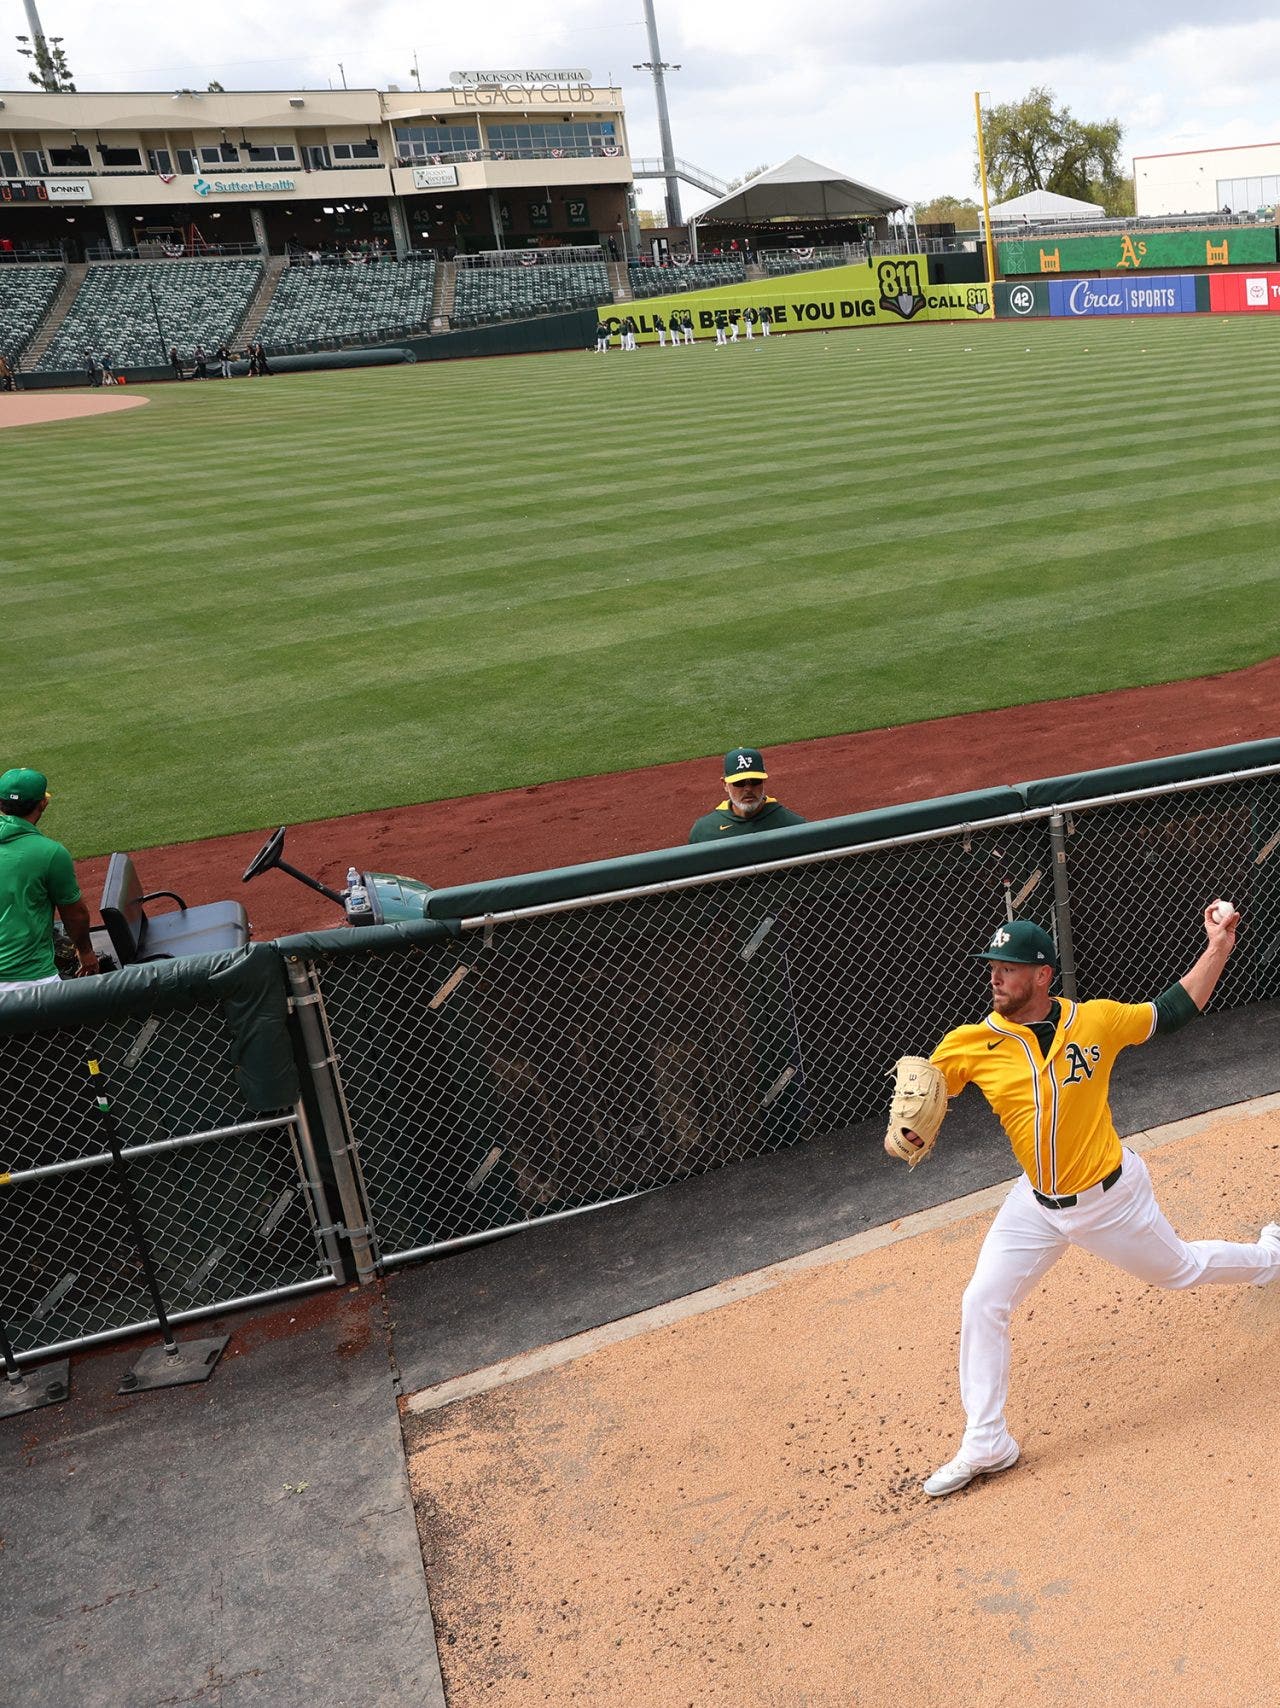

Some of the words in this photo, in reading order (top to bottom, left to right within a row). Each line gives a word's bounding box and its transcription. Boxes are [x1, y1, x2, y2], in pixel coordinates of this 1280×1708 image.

[472, 72, 522, 83] JACKSON
[525, 71, 585, 82] RANCHERIA
[451, 84, 535, 107] LEGACY
[540, 83, 595, 103] CLUB
[531, 205, 547, 217] 34
[569, 203, 585, 215] 27
[1116, 234, 1147, 267] A's
[880, 261, 921, 298] 811
[928, 296, 965, 309] CALL
[967, 288, 987, 304] 811
[1013, 291, 1029, 307] 42
[1069, 281, 1124, 315] Circa
[1130, 288, 1175, 308] SPORTS
[791, 302, 835, 321] YOU
[841, 299, 876, 318] DIG
[736, 755, 753, 770] A's
[990, 927, 1011, 948] A's
[1062, 1042, 1102, 1088] A's
